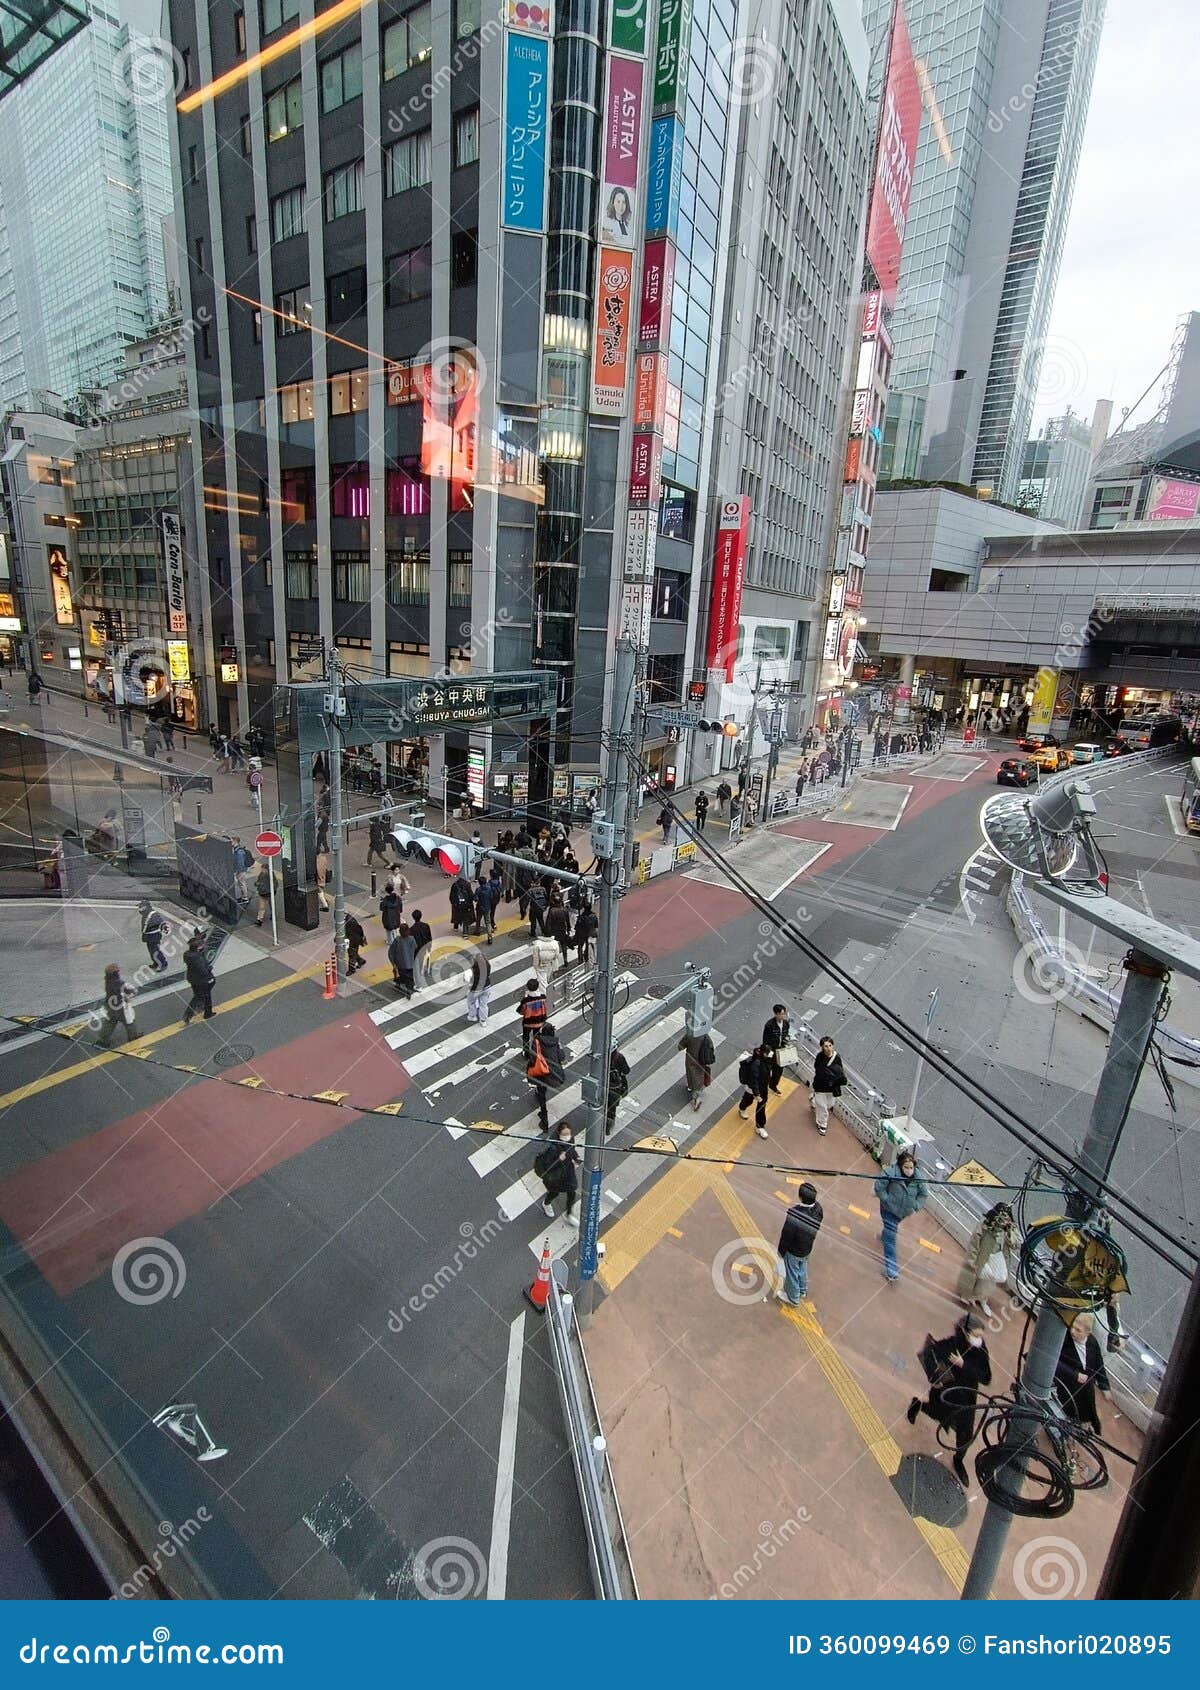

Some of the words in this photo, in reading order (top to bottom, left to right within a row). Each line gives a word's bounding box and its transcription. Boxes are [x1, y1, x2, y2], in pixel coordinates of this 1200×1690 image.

[527, 71, 542, 145] アリシア
[619, 87, 636, 159] ASTRA
[509, 127, 526, 216] クリニック
[650, 265, 660, 303] ASTRA
[865, 293, 878, 330] カラオケ
[594, 387, 624, 398] Sanuki
[596, 397, 621, 407] Udon
[638, 443, 648, 477] ASTRA
[168, 543, 184, 611] Corn-Barley
[417, 687, 486, 707] 渋谷中央街
[453, 706, 490, 718] CHUO-GAI
